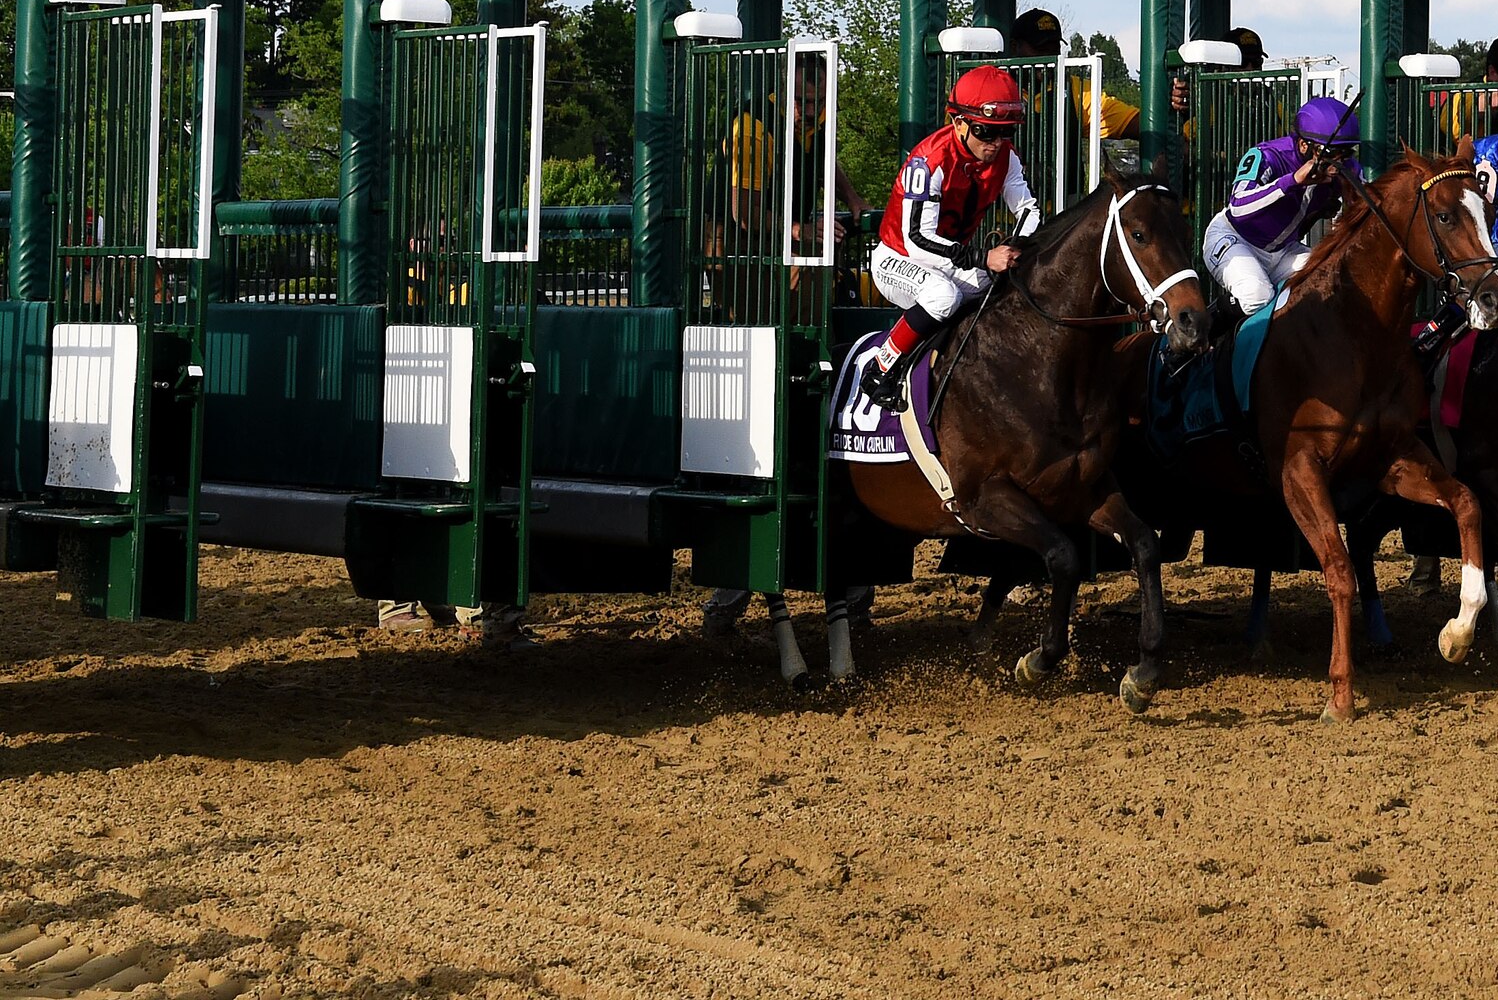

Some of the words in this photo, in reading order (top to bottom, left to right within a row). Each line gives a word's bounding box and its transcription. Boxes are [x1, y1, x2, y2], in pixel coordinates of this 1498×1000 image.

[1238, 154, 1256, 177] 9
[904, 166, 926, 195] 10
[1477, 170, 1490, 195] 8
[833, 433, 853, 451] RIDE
[853, 434, 865, 452] ON
[866, 435, 896, 453] CURLIN
